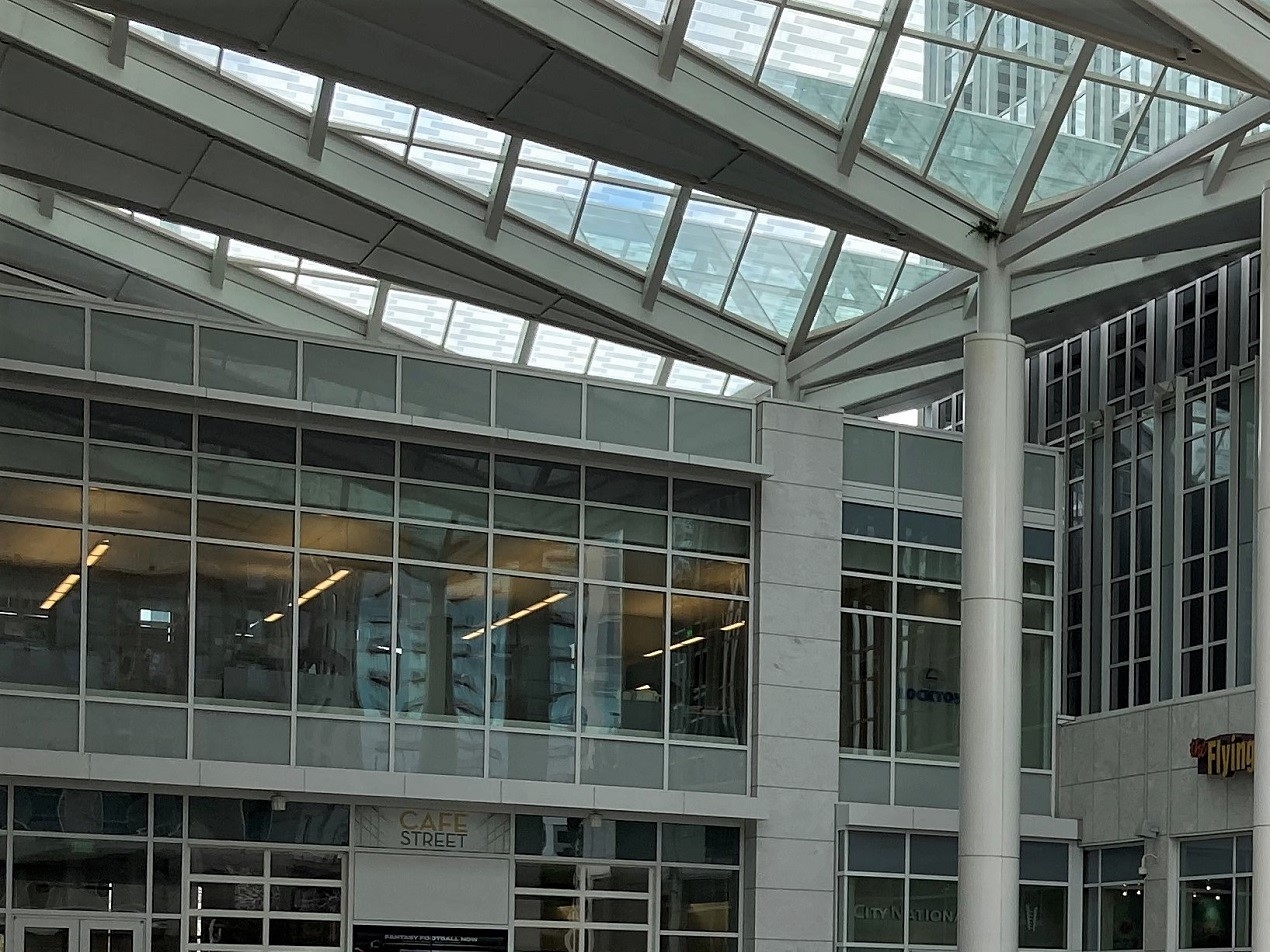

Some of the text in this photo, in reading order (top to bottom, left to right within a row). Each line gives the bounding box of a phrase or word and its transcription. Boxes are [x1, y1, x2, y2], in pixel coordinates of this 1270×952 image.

[400, 810, 469, 833] CAFE
[400, 830, 468, 848] STREET
[854, 904, 888, 919] CITY
